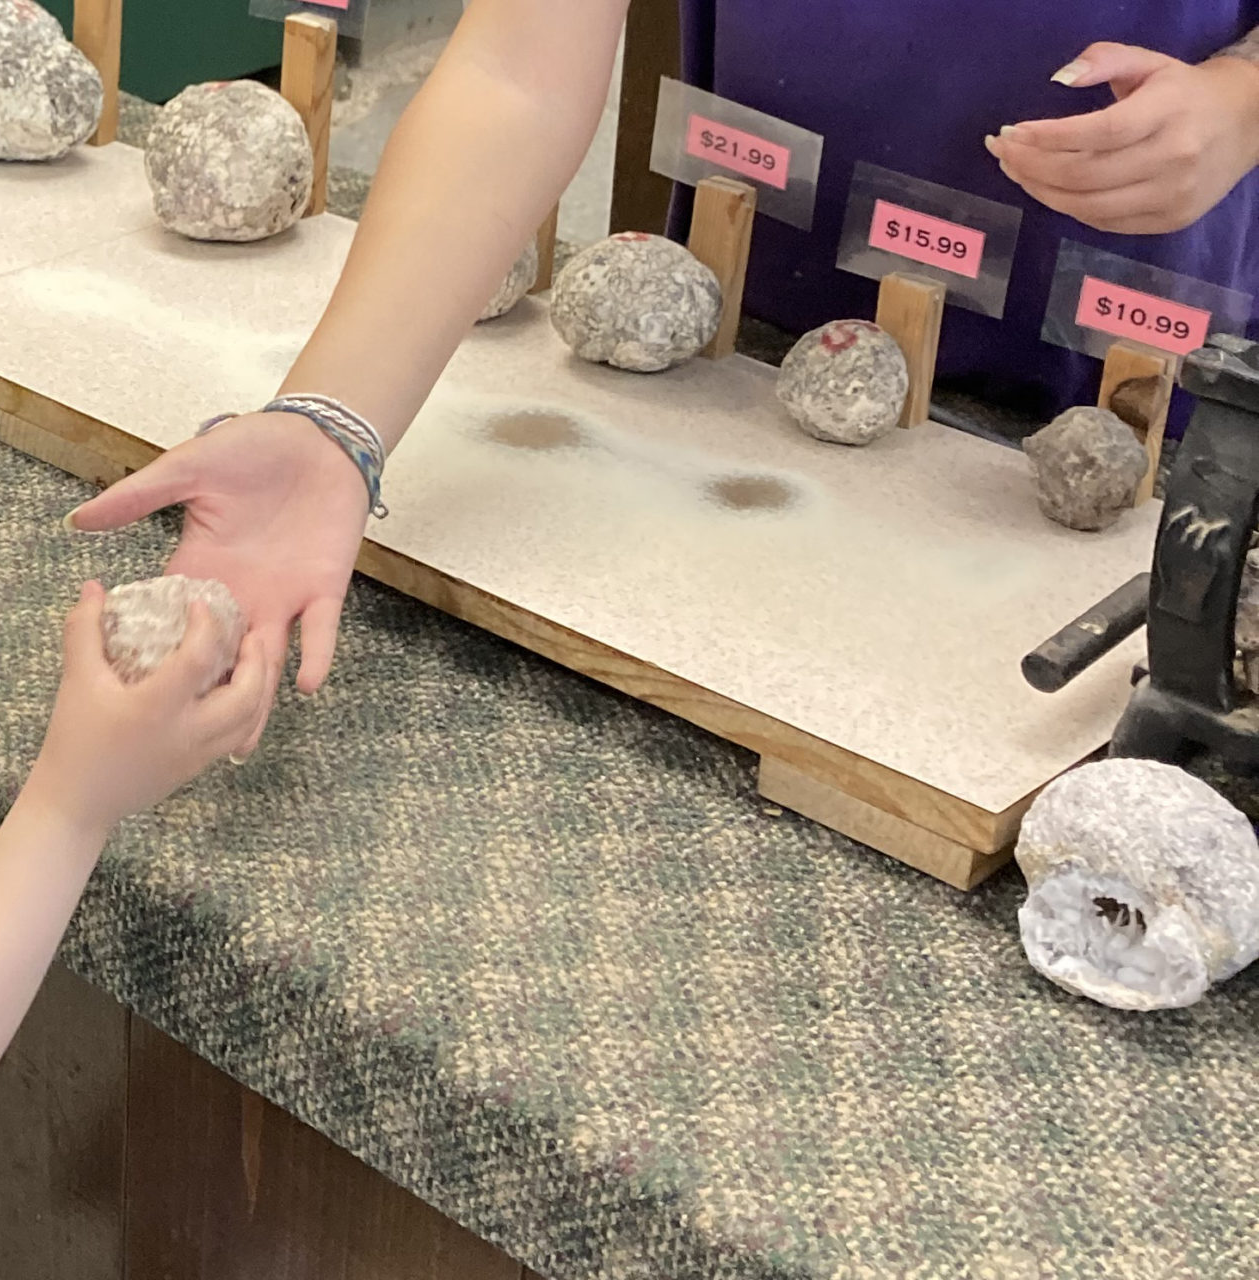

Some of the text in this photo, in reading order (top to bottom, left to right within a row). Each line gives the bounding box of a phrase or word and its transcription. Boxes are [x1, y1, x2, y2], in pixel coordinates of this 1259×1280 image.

[700, 129, 777, 172] $21.99
[884, 219, 968, 261] $15.99
[1094, 295, 1191, 341] $10.99
